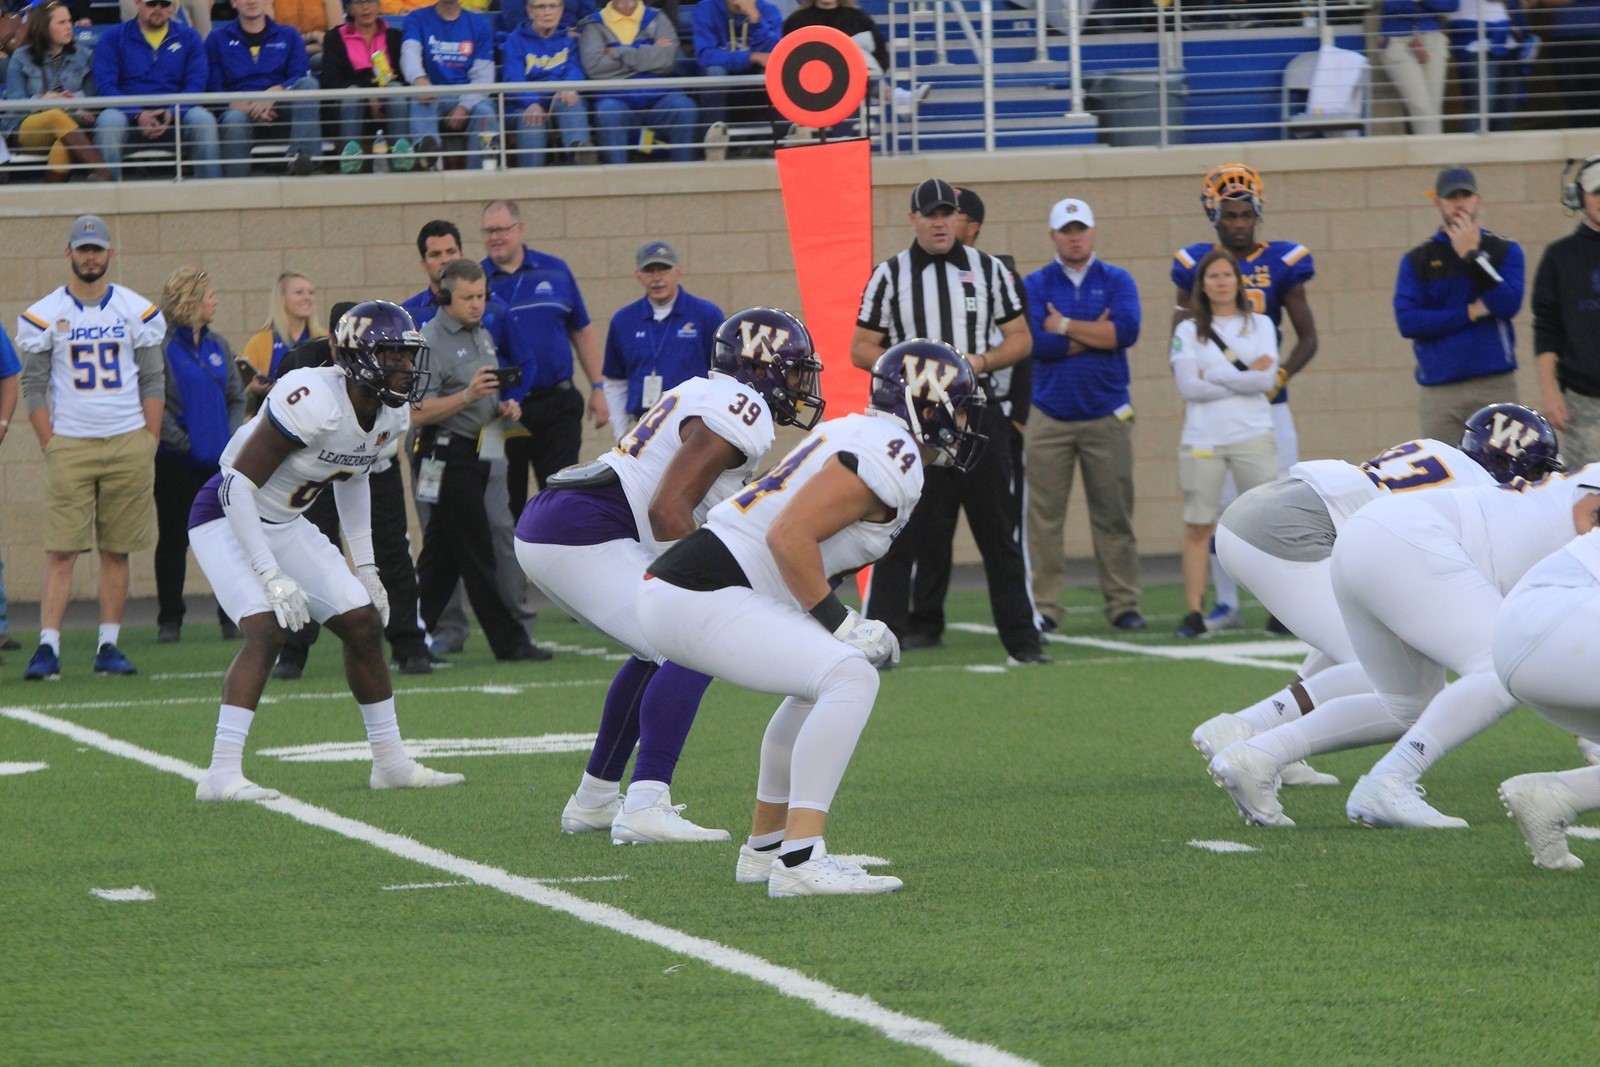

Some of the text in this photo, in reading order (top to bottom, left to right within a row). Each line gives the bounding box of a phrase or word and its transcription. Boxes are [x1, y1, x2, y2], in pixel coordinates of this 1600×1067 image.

[67, 326, 125, 341] JACKS
[740, 320, 789, 363] W
[69, 341, 122, 391] 59
[902, 354, 958, 403] W
[286, 385, 310, 406] 6
[728, 392, 762, 427] 39
[1488, 412, 1540, 458] W
[886, 438, 916, 476] 44
